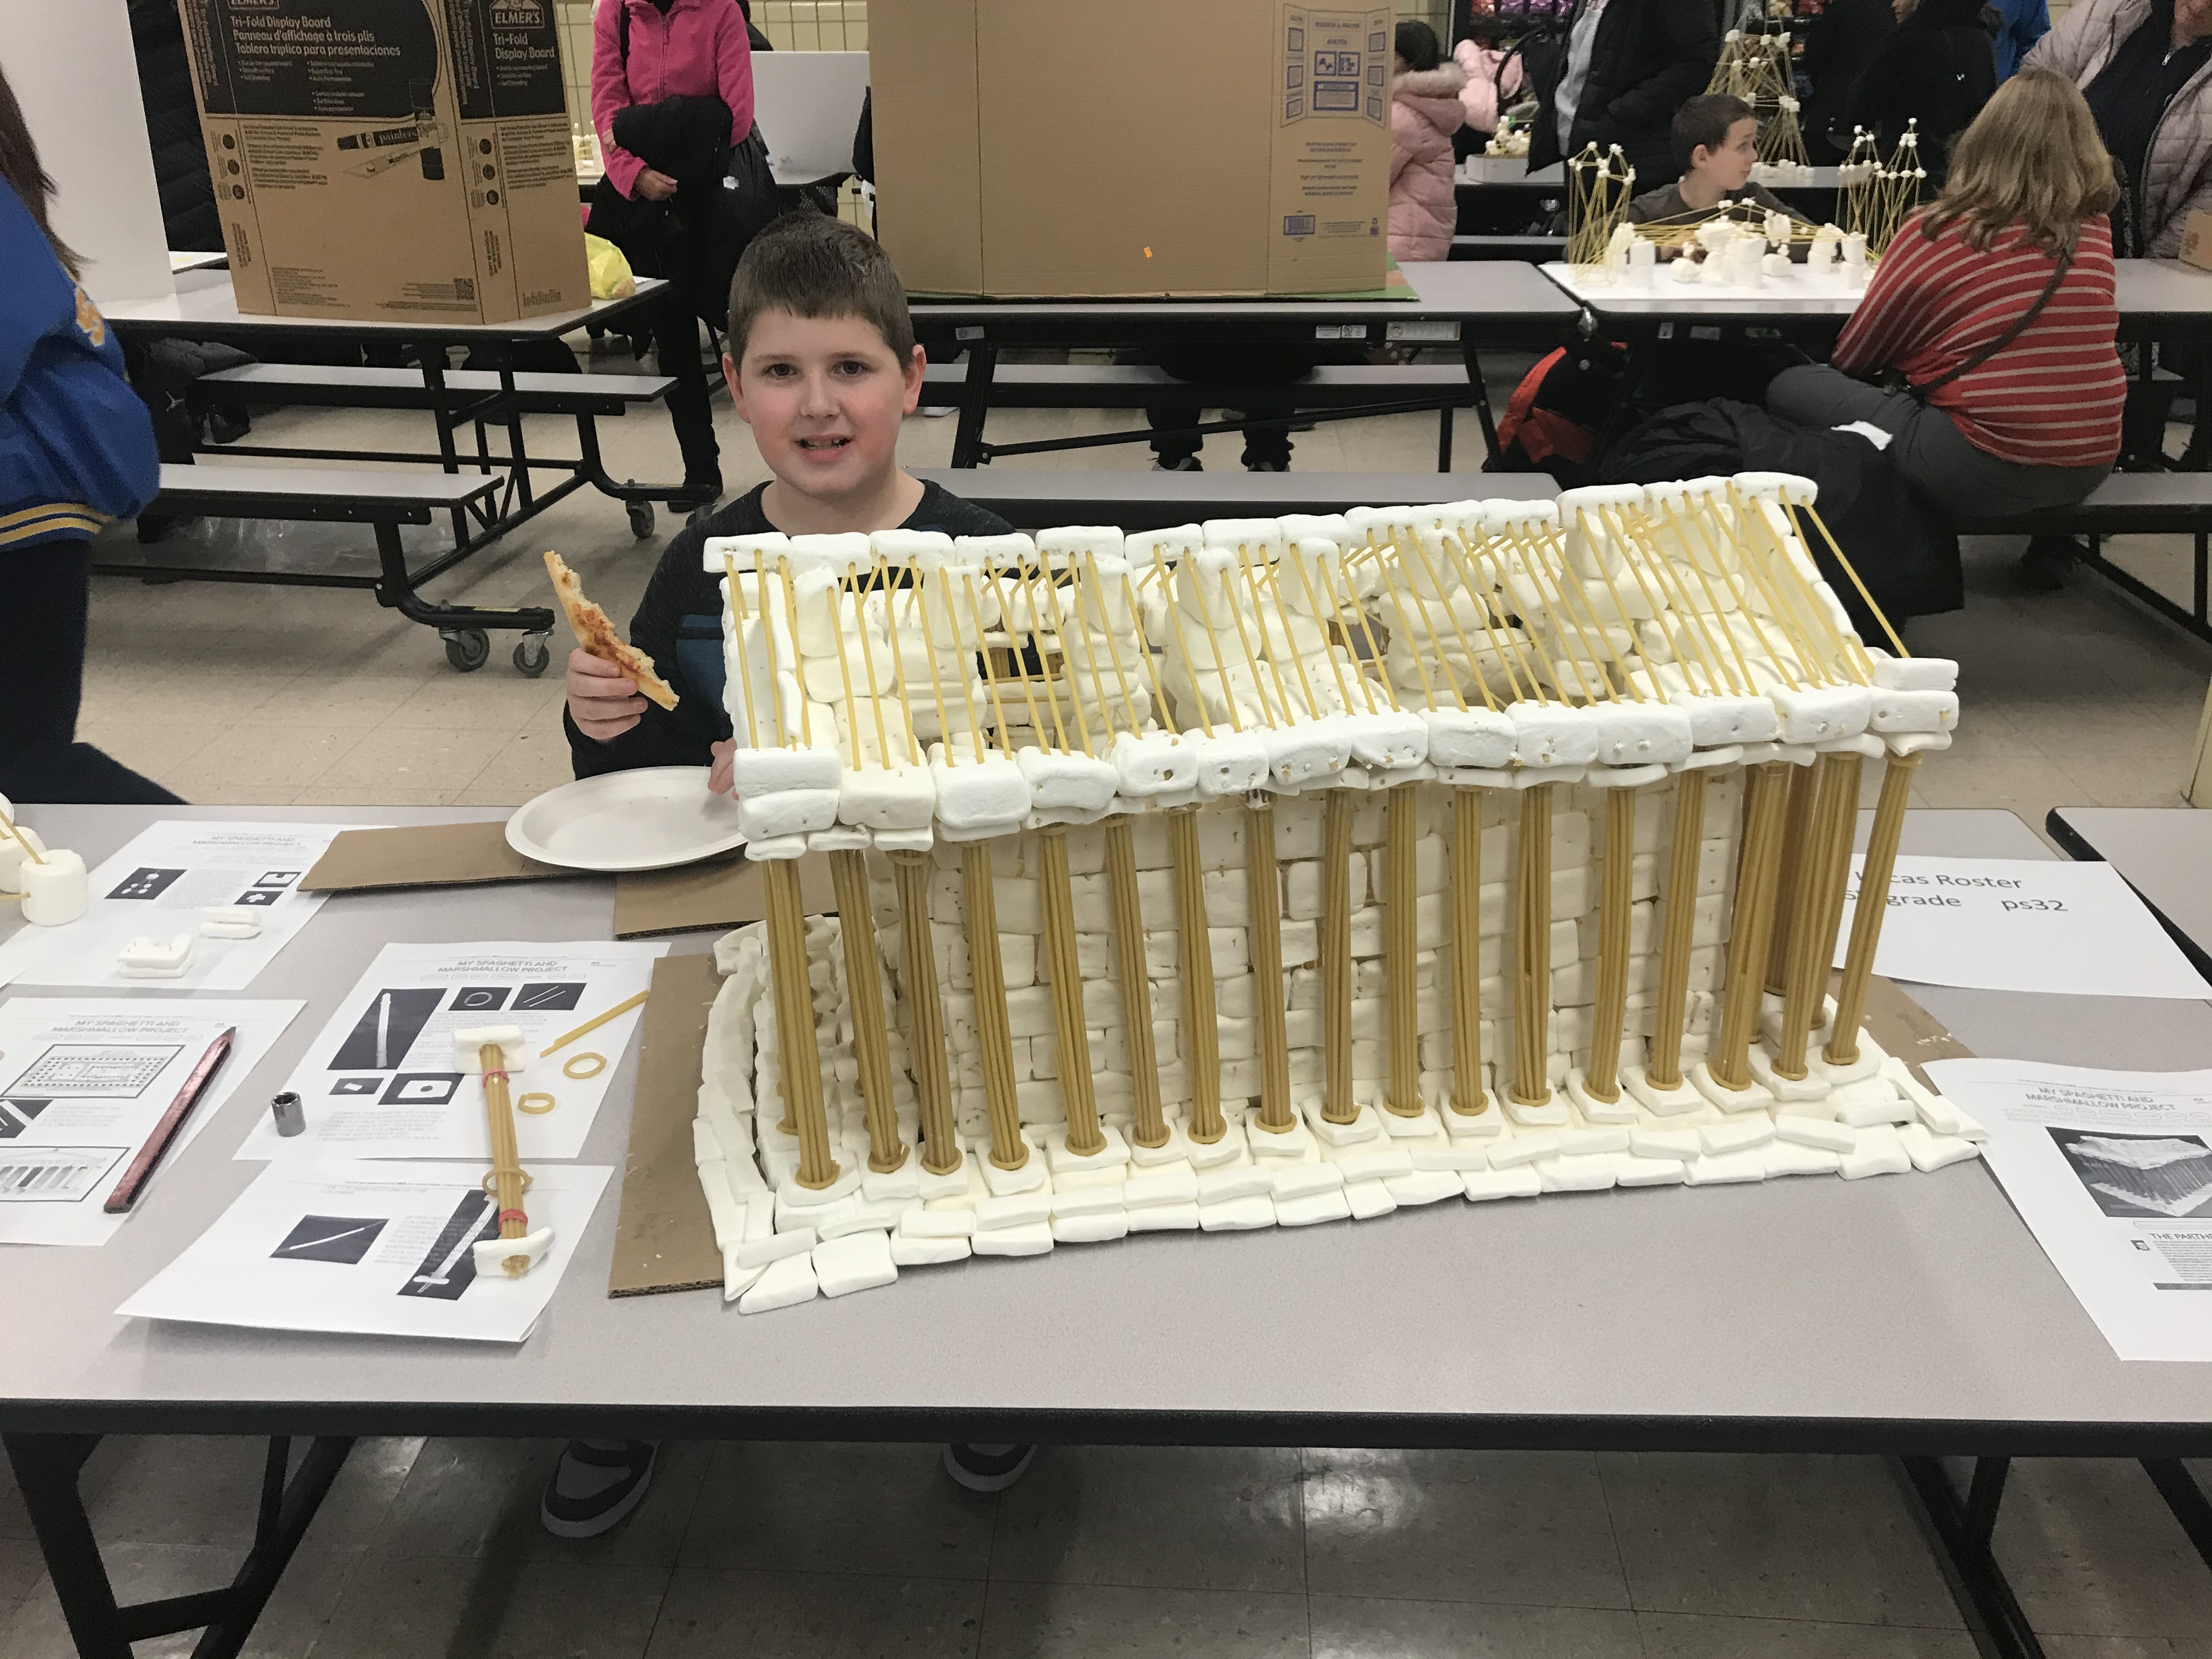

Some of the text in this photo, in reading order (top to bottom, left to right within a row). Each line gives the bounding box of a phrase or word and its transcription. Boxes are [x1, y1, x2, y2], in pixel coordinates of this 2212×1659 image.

[230, 16, 331, 29] Tri-Fold Display Board
[495, 11, 540, 24] ELMER'S
[233, 29, 273, 41] Panneau
[358, 30, 375, 44] plis
[494, 33, 528, 45] Tri-Fold
[303, 46, 326, 57] para
[495, 47, 555, 61] Display Board
[1935, 874, 2023, 889] Roster
[1886, 894, 2069, 912] grade ps32
[2058, 1089, 2125, 1101] SPAGHETTI
[2024, 1093, 2176, 1111] MARSHMALLOW PROJECT
